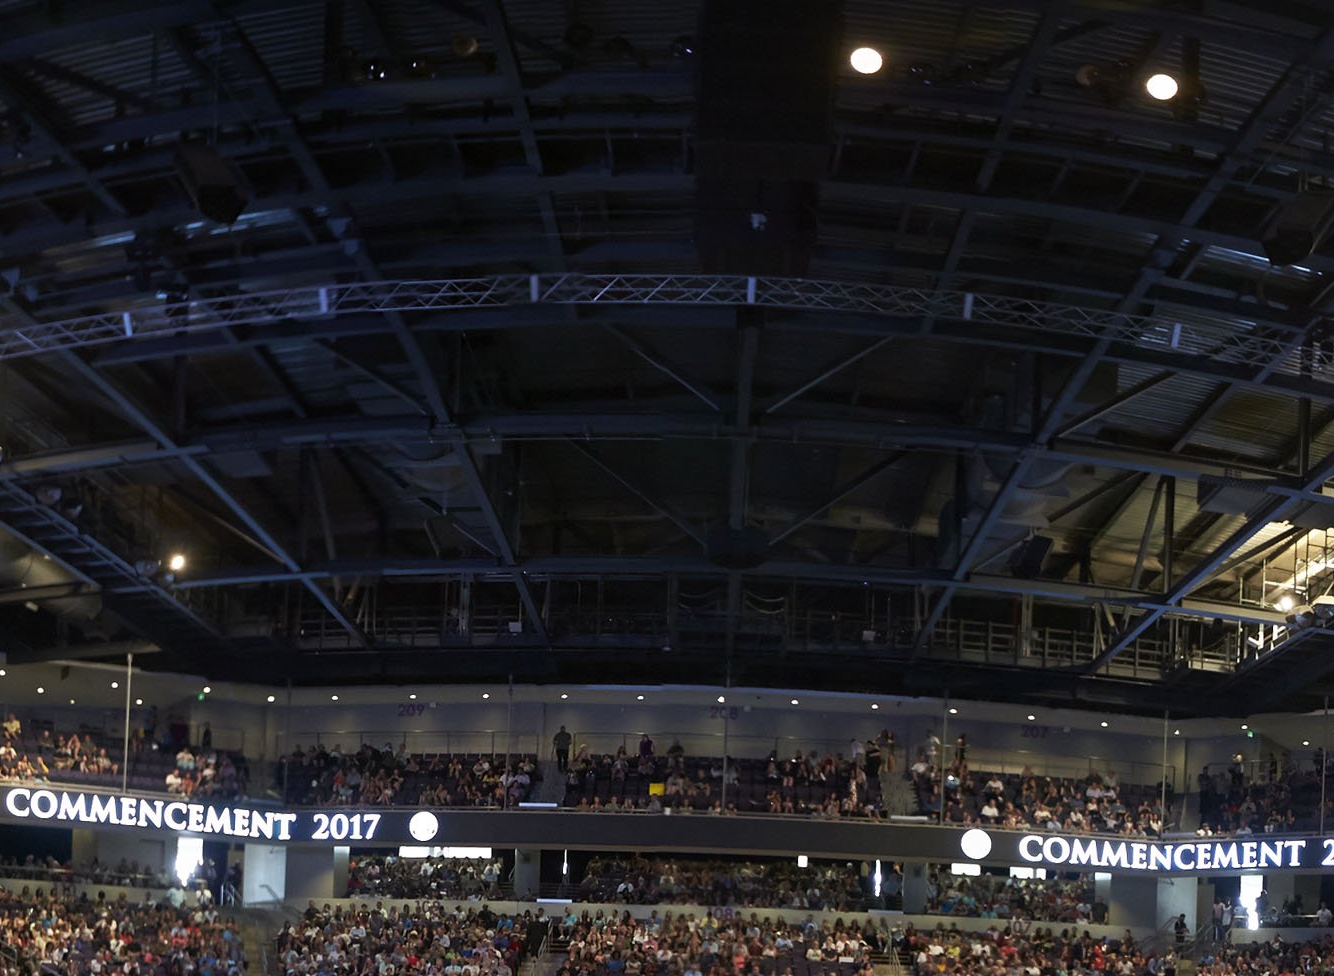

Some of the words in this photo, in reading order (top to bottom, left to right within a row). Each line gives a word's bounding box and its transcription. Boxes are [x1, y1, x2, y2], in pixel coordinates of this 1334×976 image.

[397, 703, 426, 718] 209
[1021, 724, 1050, 739] 207
[5, 786, 297, 841] COMMENCEMENT
[311, 813, 382, 840] 2017
[1018, 834, 1306, 871] COMMENCEMENT
